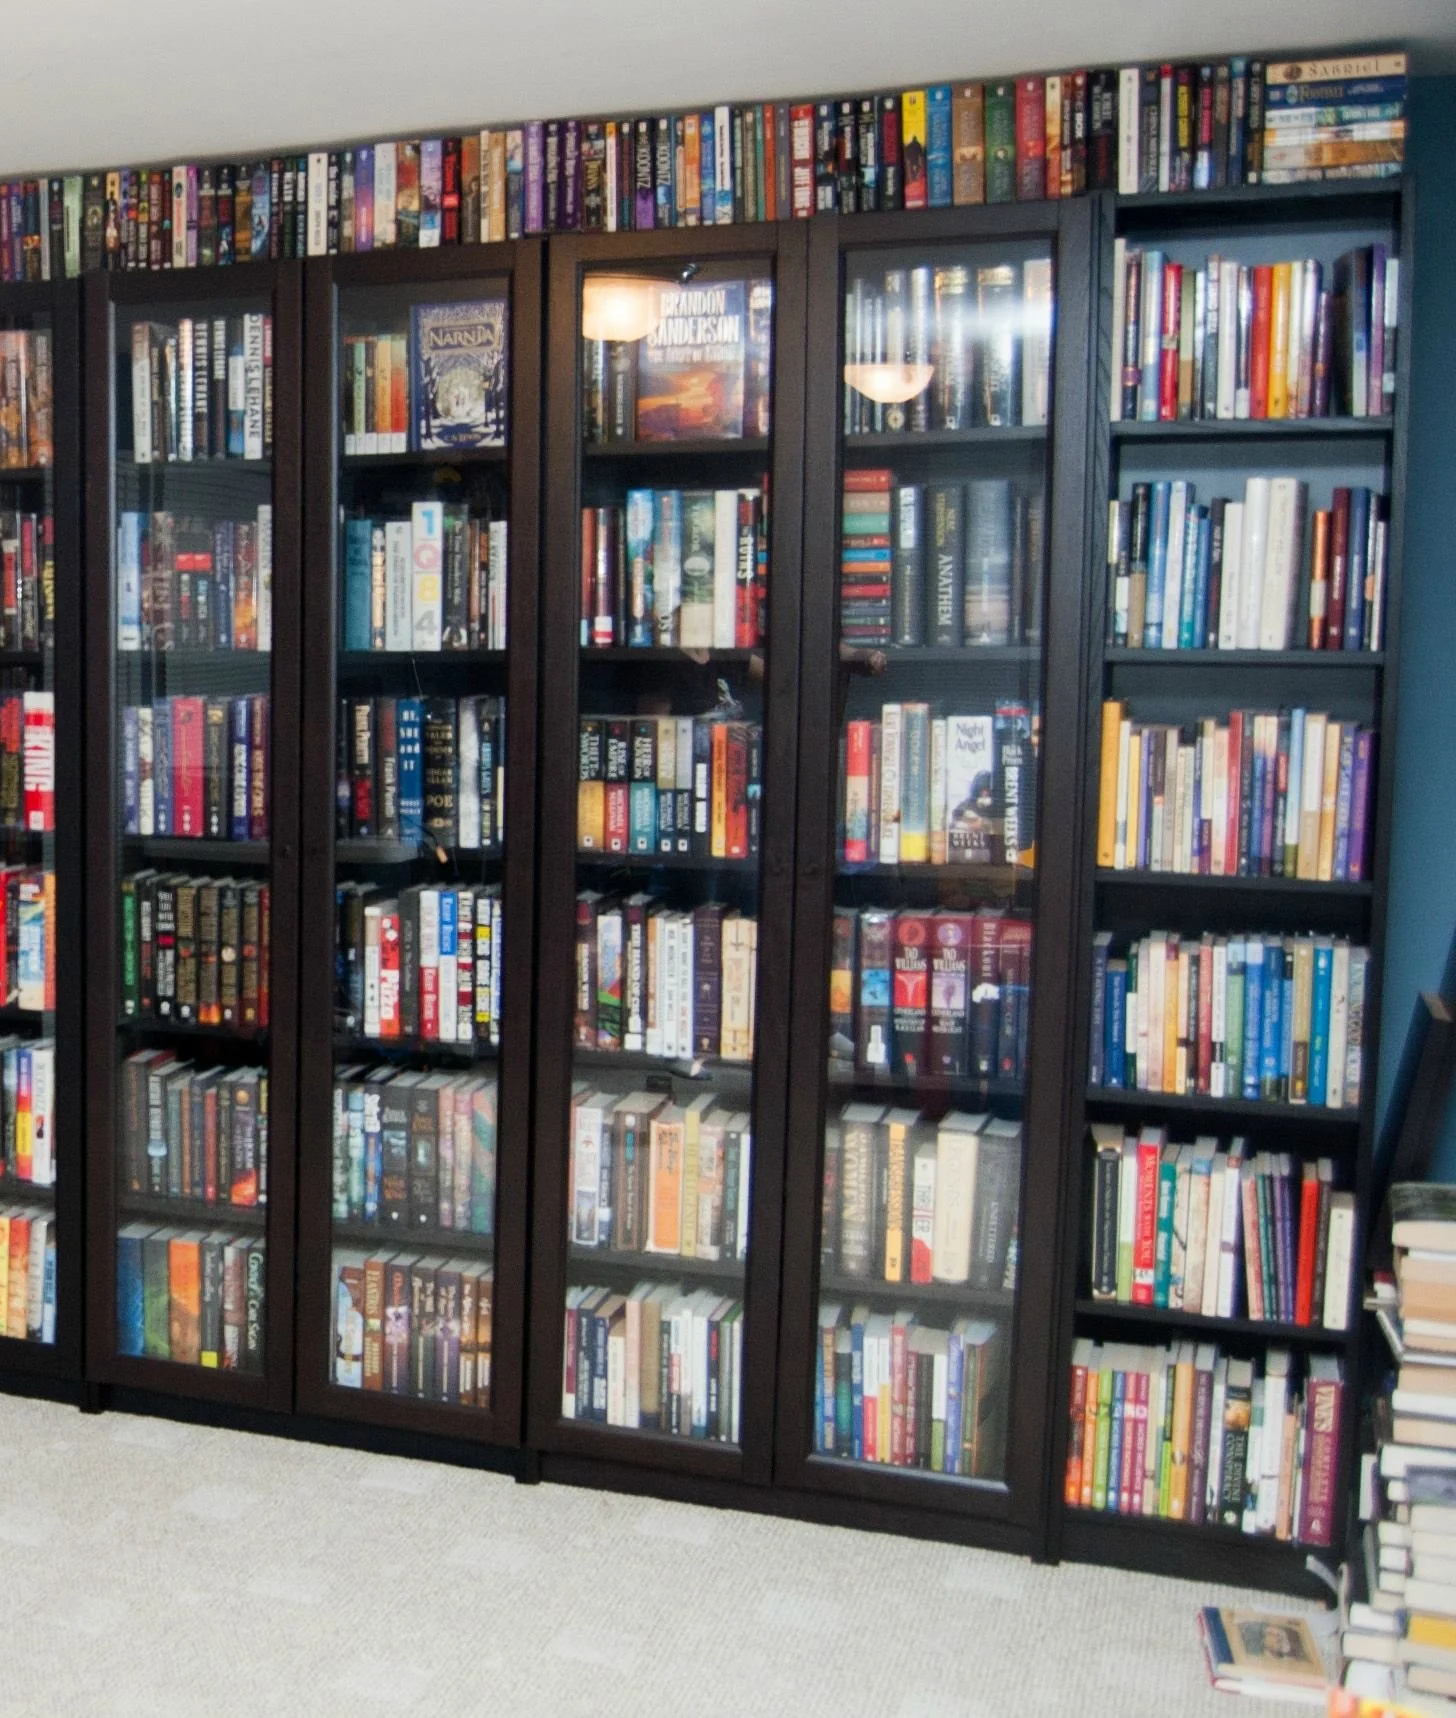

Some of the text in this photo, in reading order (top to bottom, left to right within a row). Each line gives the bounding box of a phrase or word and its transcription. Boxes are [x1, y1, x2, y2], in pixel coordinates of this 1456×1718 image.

[636, 148, 650, 189] KOONTZ
[656, 144, 670, 187] KOONTZ
[660, 290, 726, 317] BRANDON
[428, 326, 495, 348] NARNIA
[648, 315, 739, 346] SANDERSON
[249, 314, 261, 438] DENNIS LEHANE
[737, 537, 753, 580] RUINS
[938, 554, 952, 625] ANATHEM
[955, 722, 985, 739] Night
[955, 737, 986, 752] Angel
[426, 794, 453, 808] POE
[1004, 767, 1018, 846] BRENT WEEKS
[366, 1270, 381, 1315] ELANTRIS
[1223, 1432, 1235, 1502] CONSPIRACY
[1232, 1435, 1244, 1502] THE DIVINE
